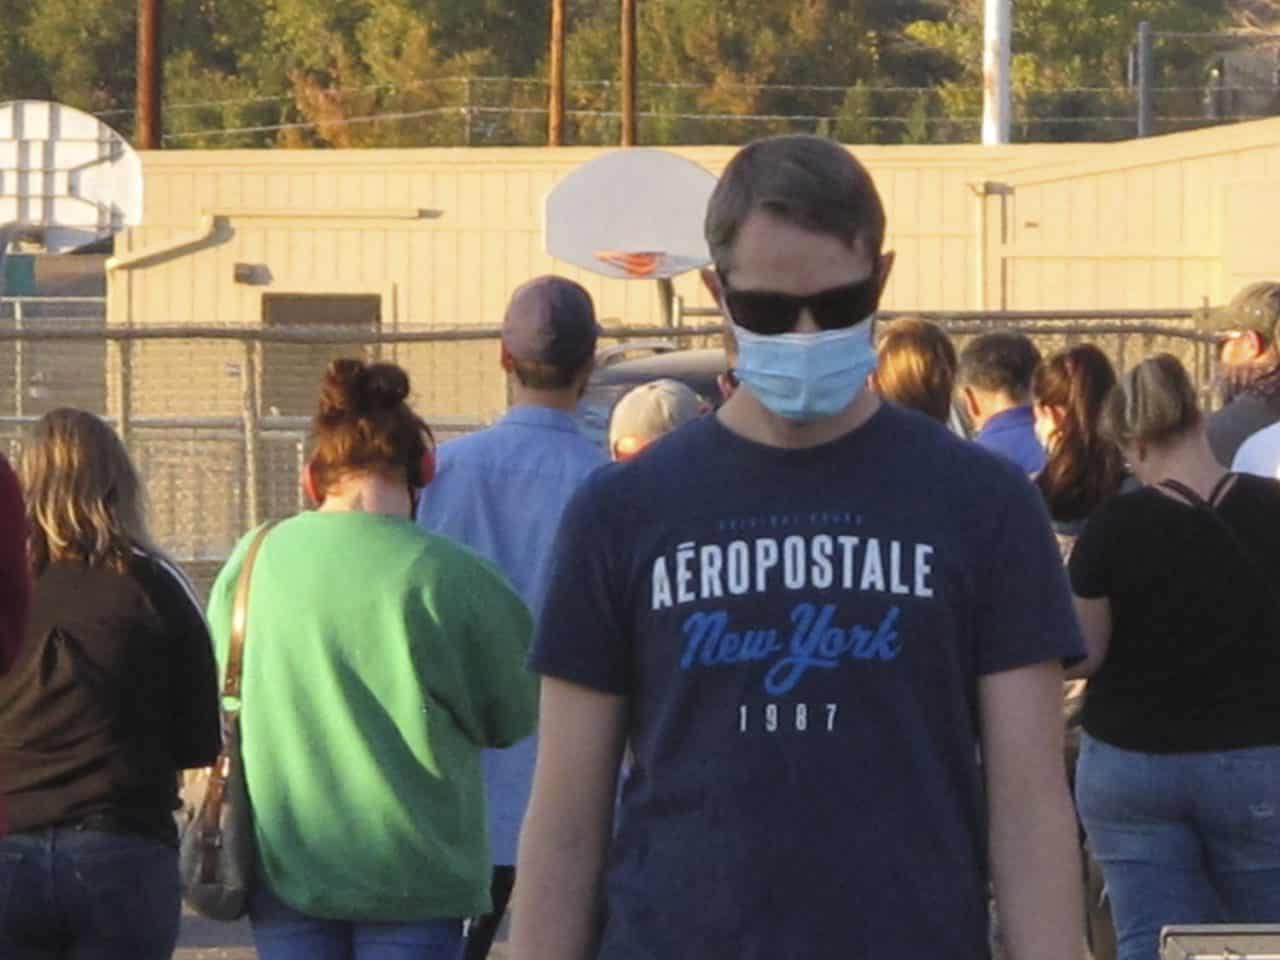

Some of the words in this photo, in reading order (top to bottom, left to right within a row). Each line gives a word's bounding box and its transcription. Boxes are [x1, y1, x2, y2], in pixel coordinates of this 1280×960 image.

[679, 609, 782, 671] New
[763, 602, 901, 696] York
[739, 703, 837, 732] 1987
